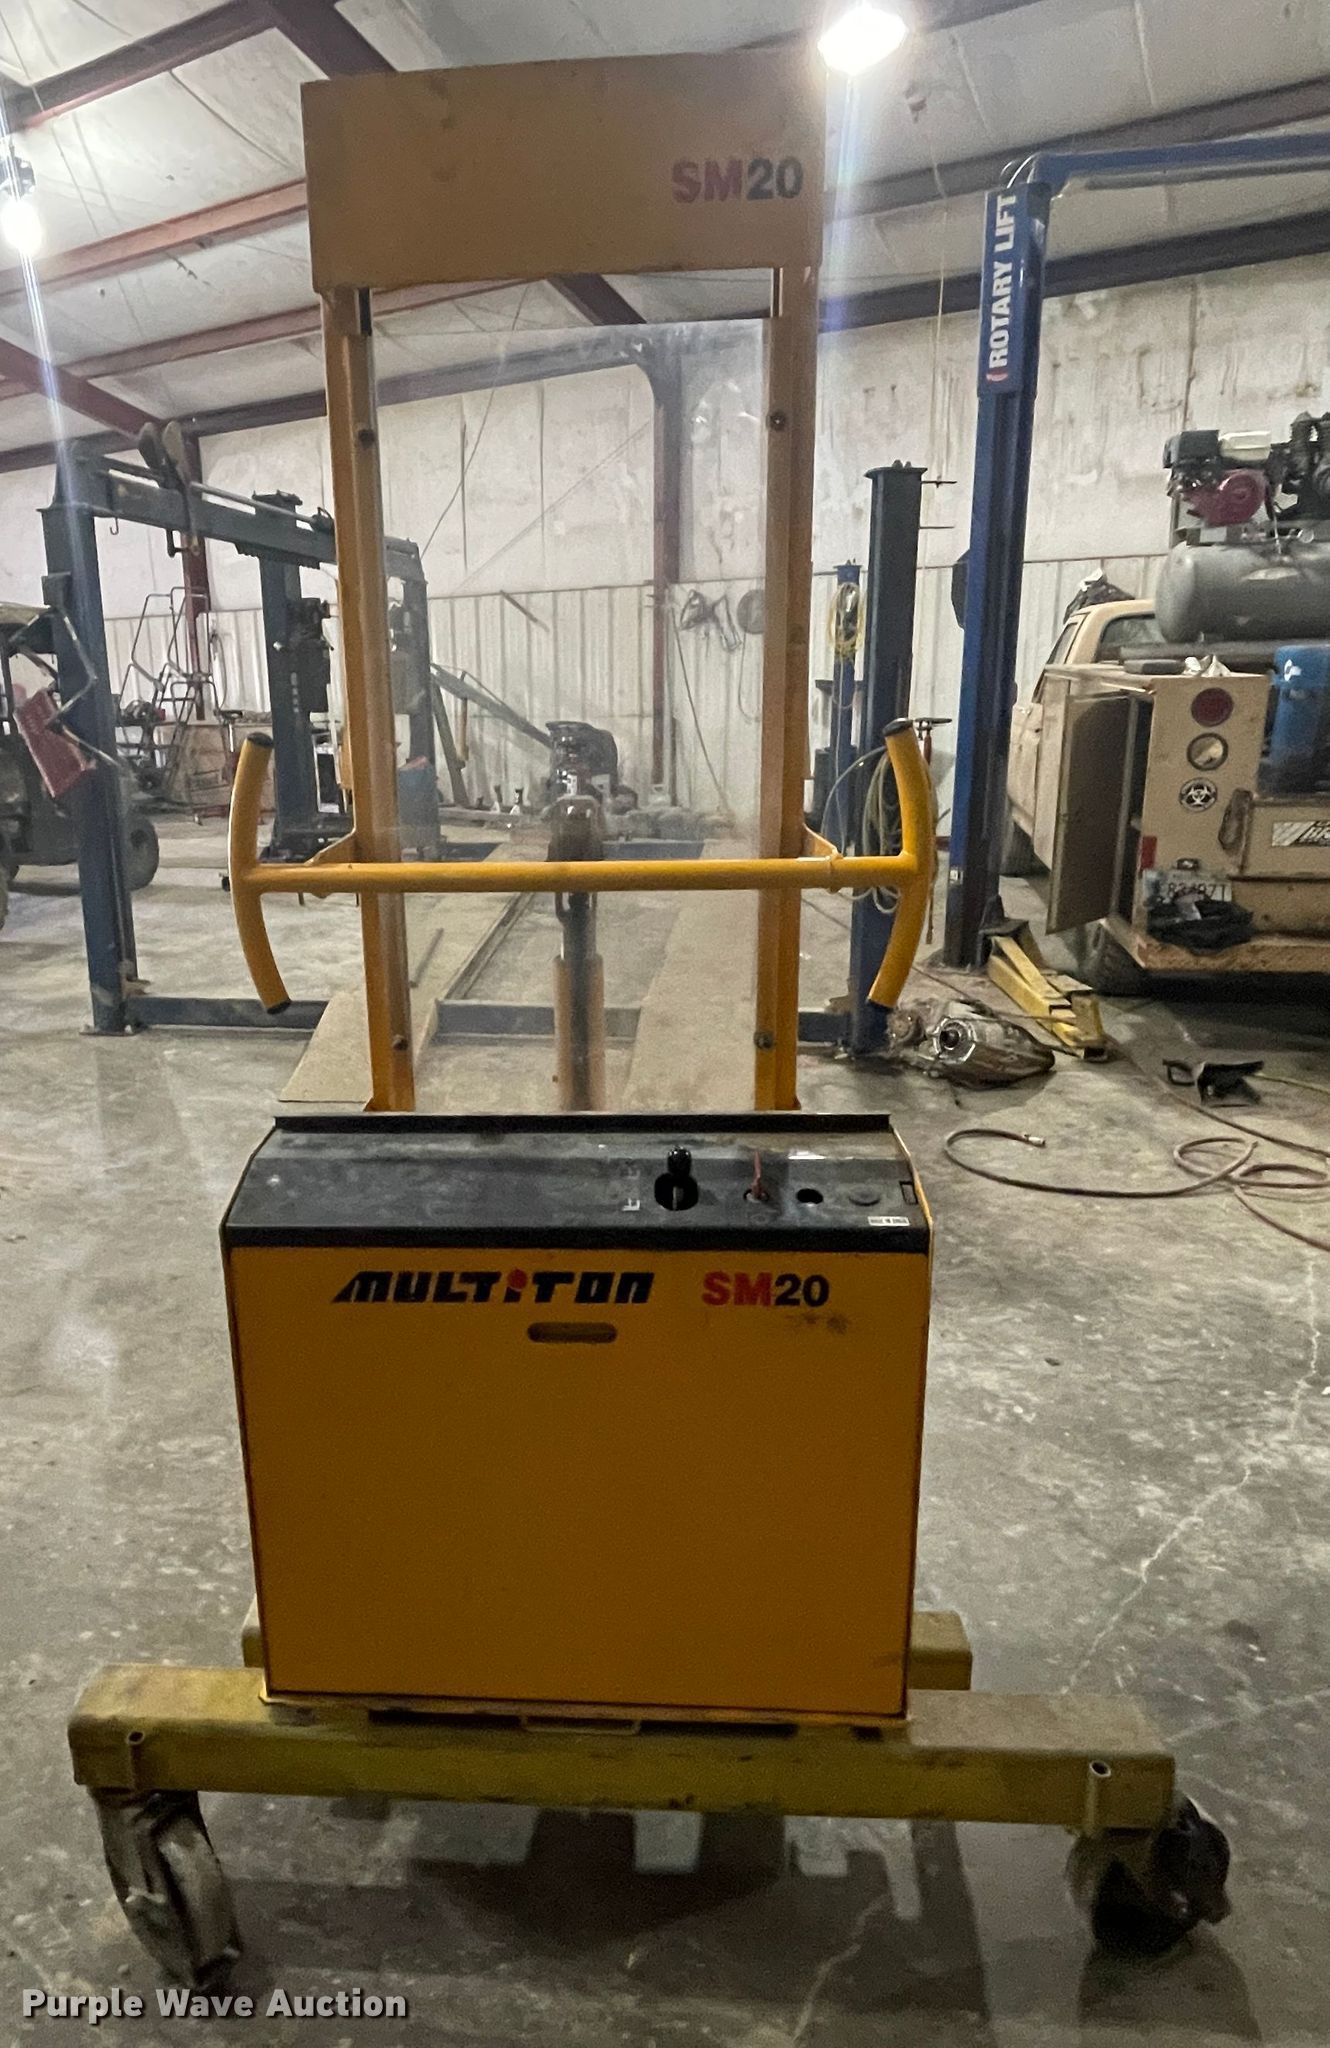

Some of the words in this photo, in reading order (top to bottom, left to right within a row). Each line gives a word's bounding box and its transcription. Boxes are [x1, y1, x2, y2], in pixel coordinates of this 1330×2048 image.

[672, 157, 803, 203] SM20
[994, 195, 1016, 252] LIFT
[988, 261, 1012, 369] ROTARY
[702, 1271, 829, 1307] SM20
